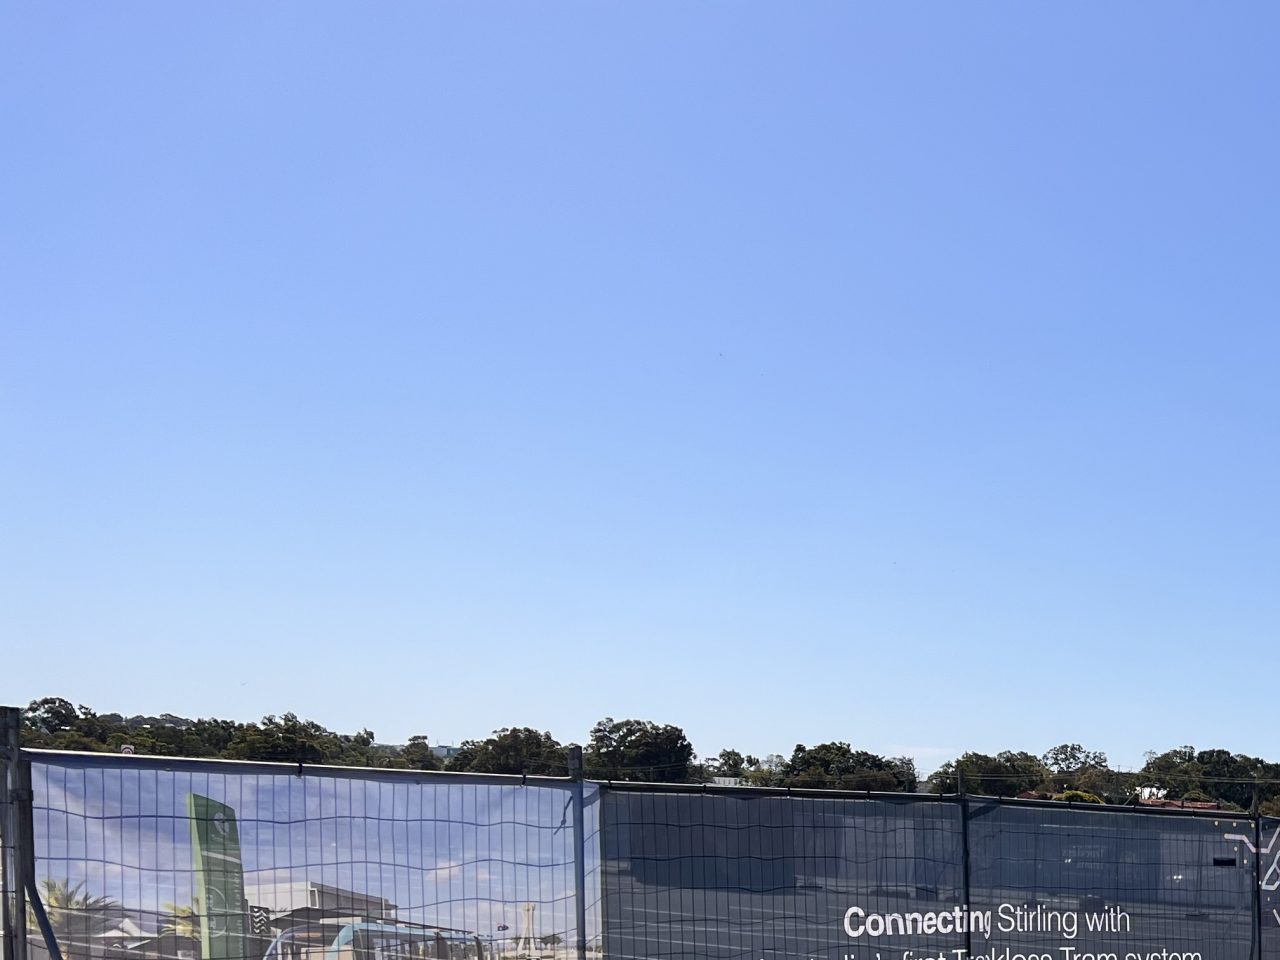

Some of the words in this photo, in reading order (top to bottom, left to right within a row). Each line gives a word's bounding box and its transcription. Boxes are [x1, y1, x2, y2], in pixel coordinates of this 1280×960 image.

[843, 904, 991, 940] Connecting
[997, 903, 1078, 939] Stirling
[1085, 905, 1130, 933] with
